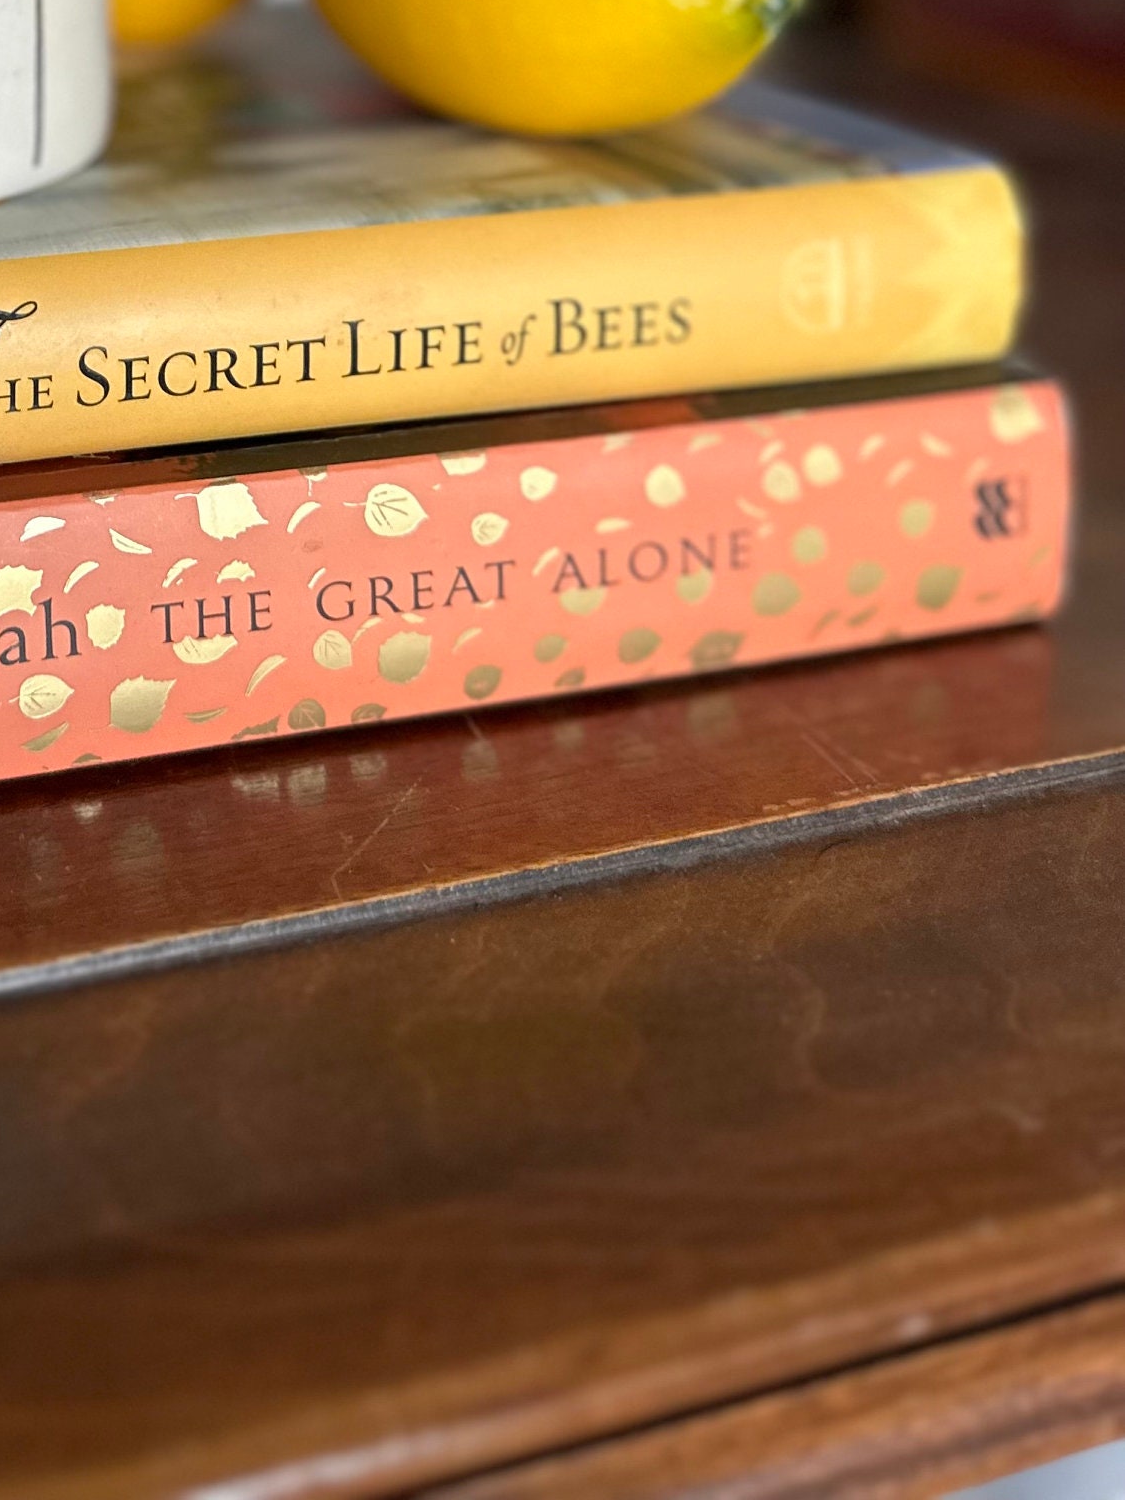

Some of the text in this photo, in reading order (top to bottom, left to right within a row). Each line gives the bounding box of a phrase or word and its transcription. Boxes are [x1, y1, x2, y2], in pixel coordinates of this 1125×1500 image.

[500, 313, 536, 366] of
[151, 528, 755, 645] THE GREAT ALONE
